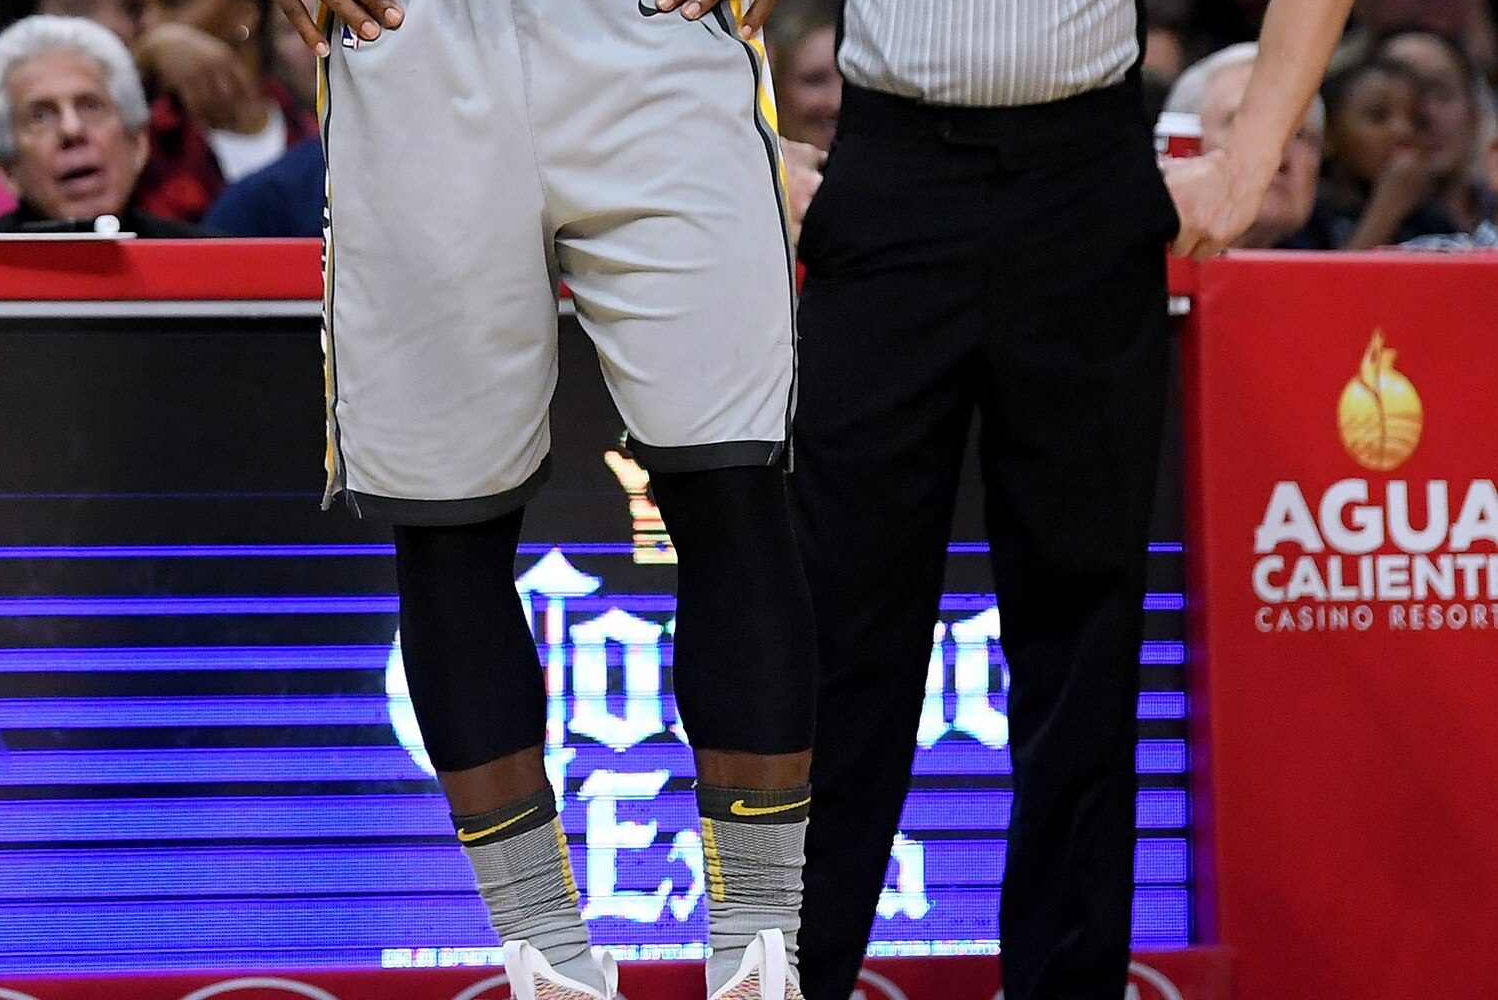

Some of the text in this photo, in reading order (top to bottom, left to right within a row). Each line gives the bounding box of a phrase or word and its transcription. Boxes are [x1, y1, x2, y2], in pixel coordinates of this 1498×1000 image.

[1254, 478, 1498, 555] AGUA
[1255, 603, 1498, 632] CASINO RESORT
